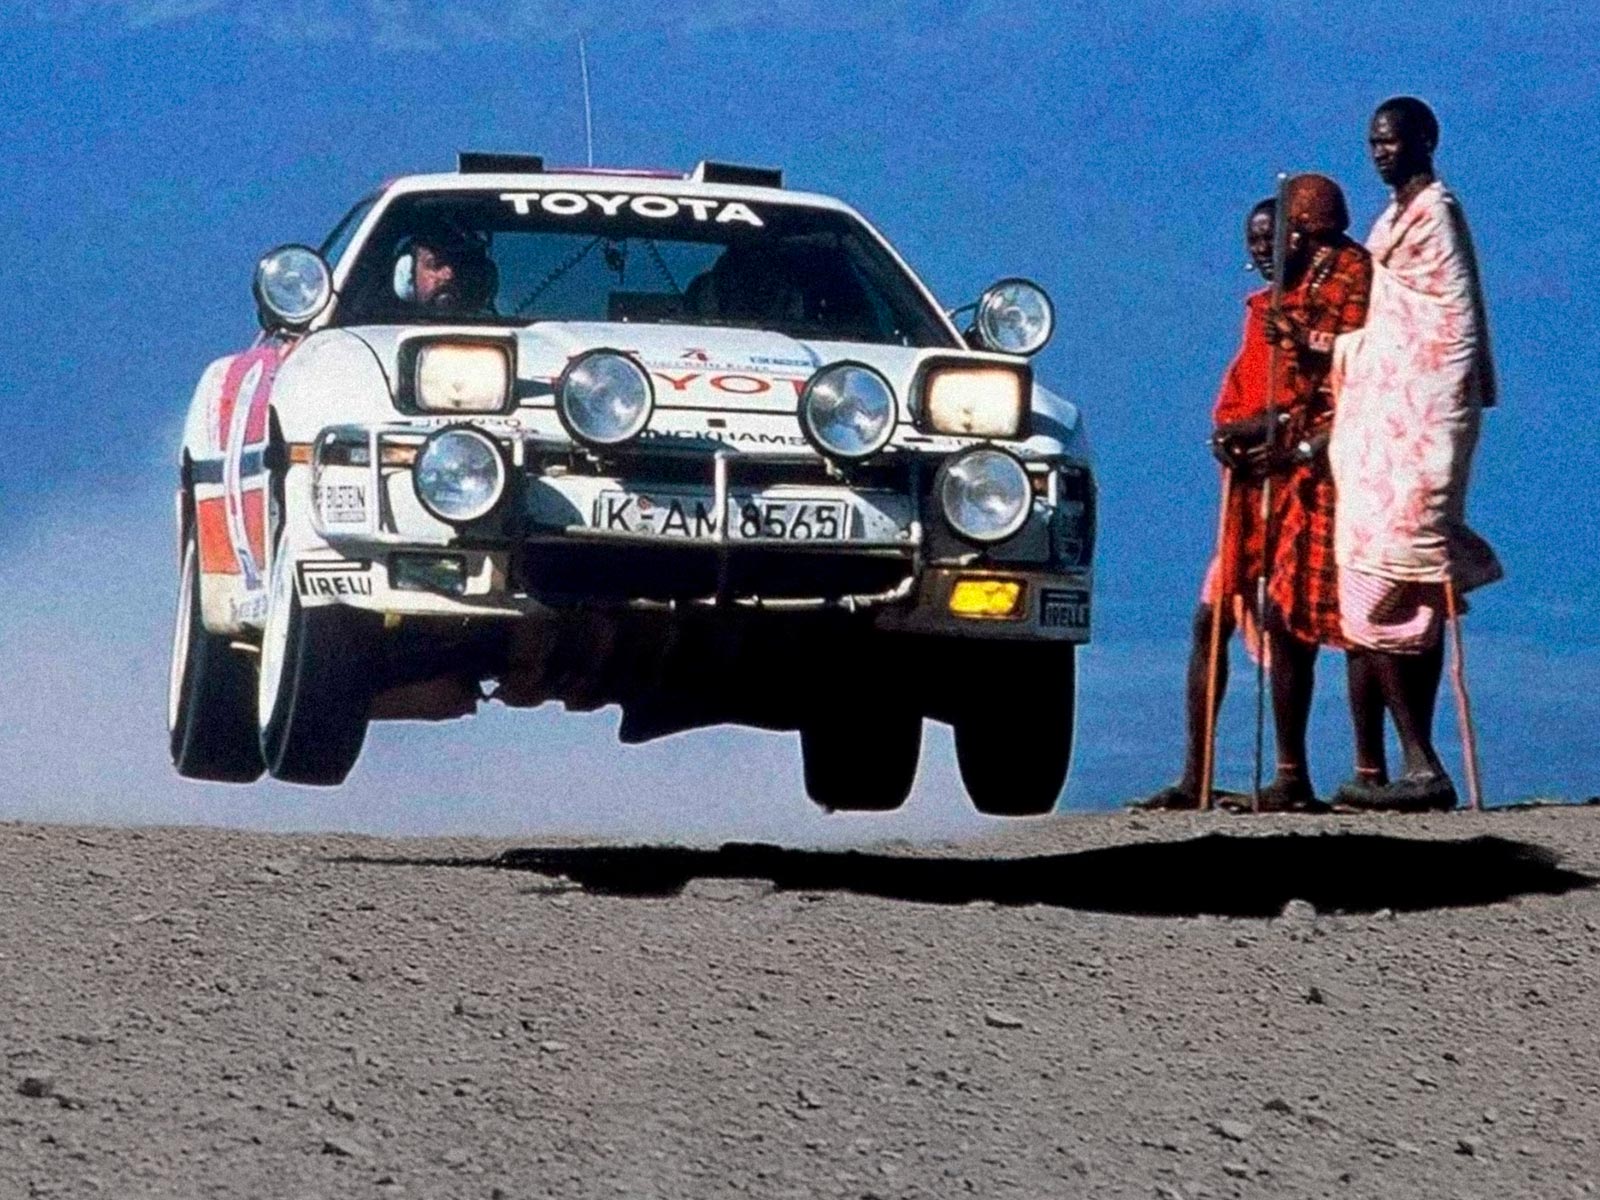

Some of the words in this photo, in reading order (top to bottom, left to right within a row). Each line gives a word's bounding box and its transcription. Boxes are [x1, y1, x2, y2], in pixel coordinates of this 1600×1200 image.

[499, 191, 764, 227] TOYOTA
[607, 498, 719, 538] K-AM
[740, 502, 839, 540] 8565
[296, 560, 372, 596] PIRELLI
